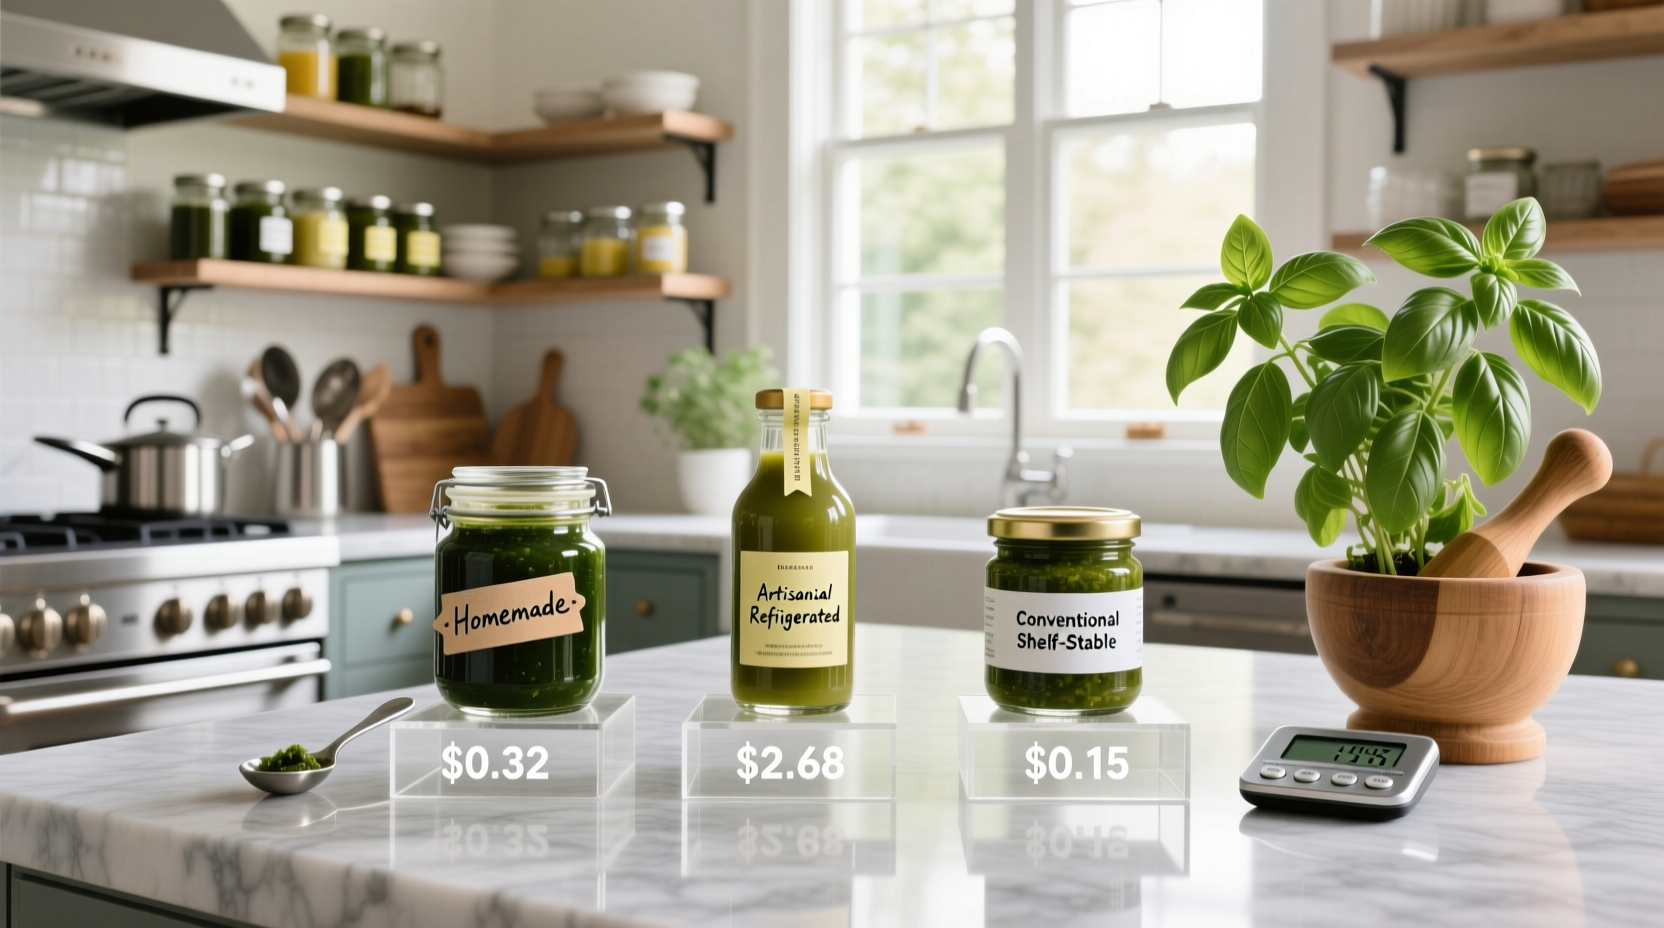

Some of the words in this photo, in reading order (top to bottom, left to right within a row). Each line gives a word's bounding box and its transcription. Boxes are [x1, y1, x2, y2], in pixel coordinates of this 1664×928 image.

[454, 589, 570, 636] Homemade
[757, 582, 833, 602] Artisanial
[1016, 610, 1119, 628] Conventional
[1016, 632, 1117, 651] Shelf-Stable
[441, 740, 549, 785] $0.32
[736, 740, 845, 785] $2.68
[1025, 740, 1129, 785] $0.15
